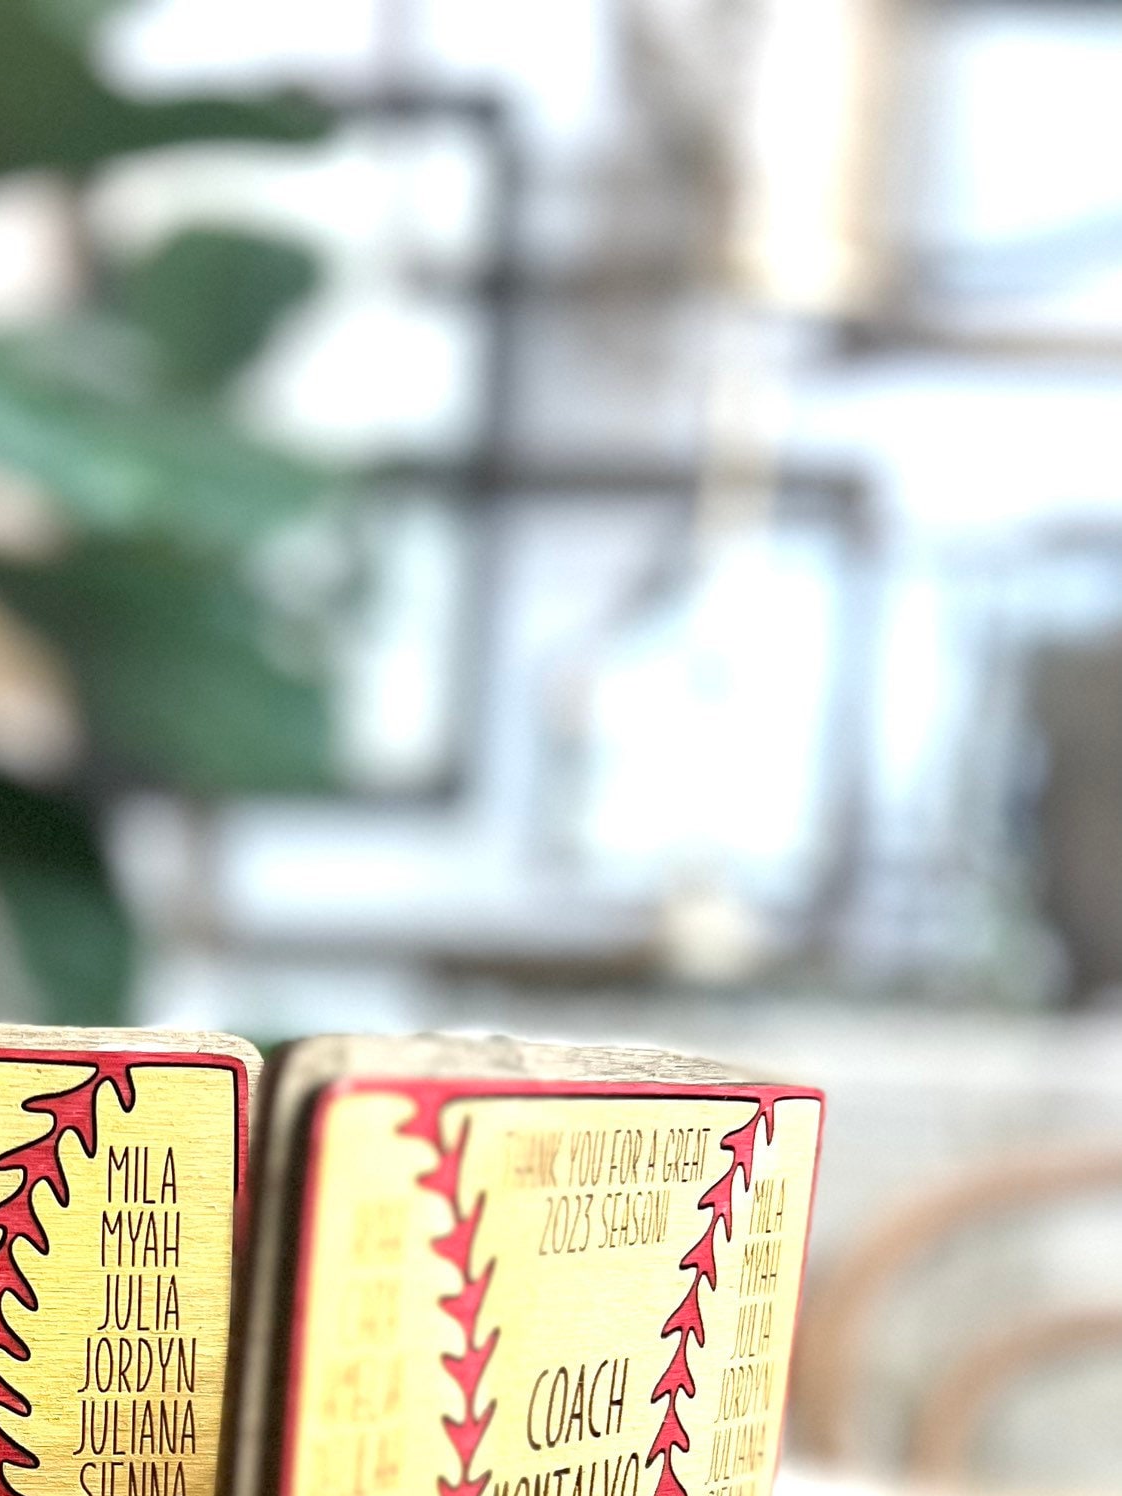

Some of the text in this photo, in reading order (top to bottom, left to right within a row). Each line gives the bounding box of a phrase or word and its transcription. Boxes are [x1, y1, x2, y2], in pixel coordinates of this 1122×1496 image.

[108, 1145, 177, 1204] MILA
[569, 1130, 607, 1187] YOU
[608, 1129, 644, 1186] FOR
[645, 1128, 658, 1183] A
[662, 1127, 712, 1183] GREAT
[538, 1189, 671, 1256] 2023 SEASON!
[748, 1178, 786, 1235] MILA
[101, 1210, 180, 1268] MYAH
[739, 1239, 782, 1298] MYAH
[97, 1274, 180, 1331] JULIA
[77, 1337, 197, 1393] JORDYN
[713, 1360, 775, 1424] JORDYN
[72, 1399, 196, 1456] JULIANA
[527, 1357, 630, 1451] COACH
